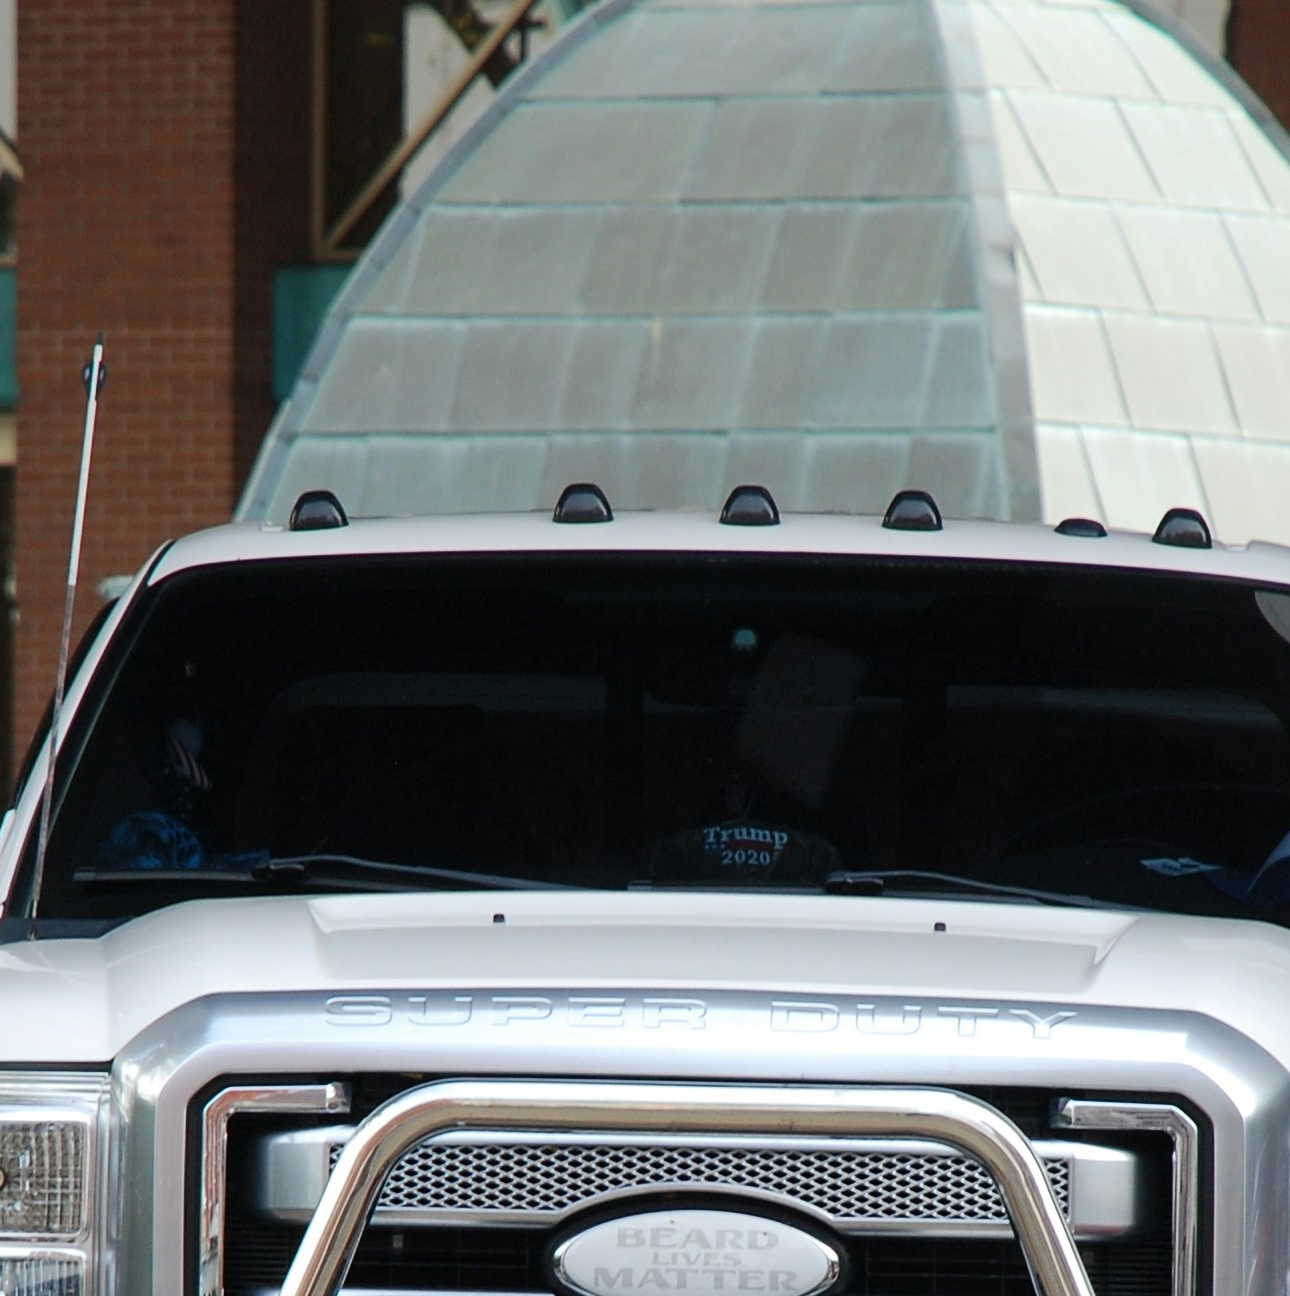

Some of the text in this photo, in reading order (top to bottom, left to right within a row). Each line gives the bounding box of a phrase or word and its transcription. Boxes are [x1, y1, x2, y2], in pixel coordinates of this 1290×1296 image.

[704, 826, 788, 849] Trump
[721, 850, 771, 864] 2020
[323, 995, 1079, 1040] SUPER DUTY
[616, 1227, 780, 1251] BEARD
[652, 1251, 743, 1268] LIVES
[593, 1266, 805, 1293] MATTER
